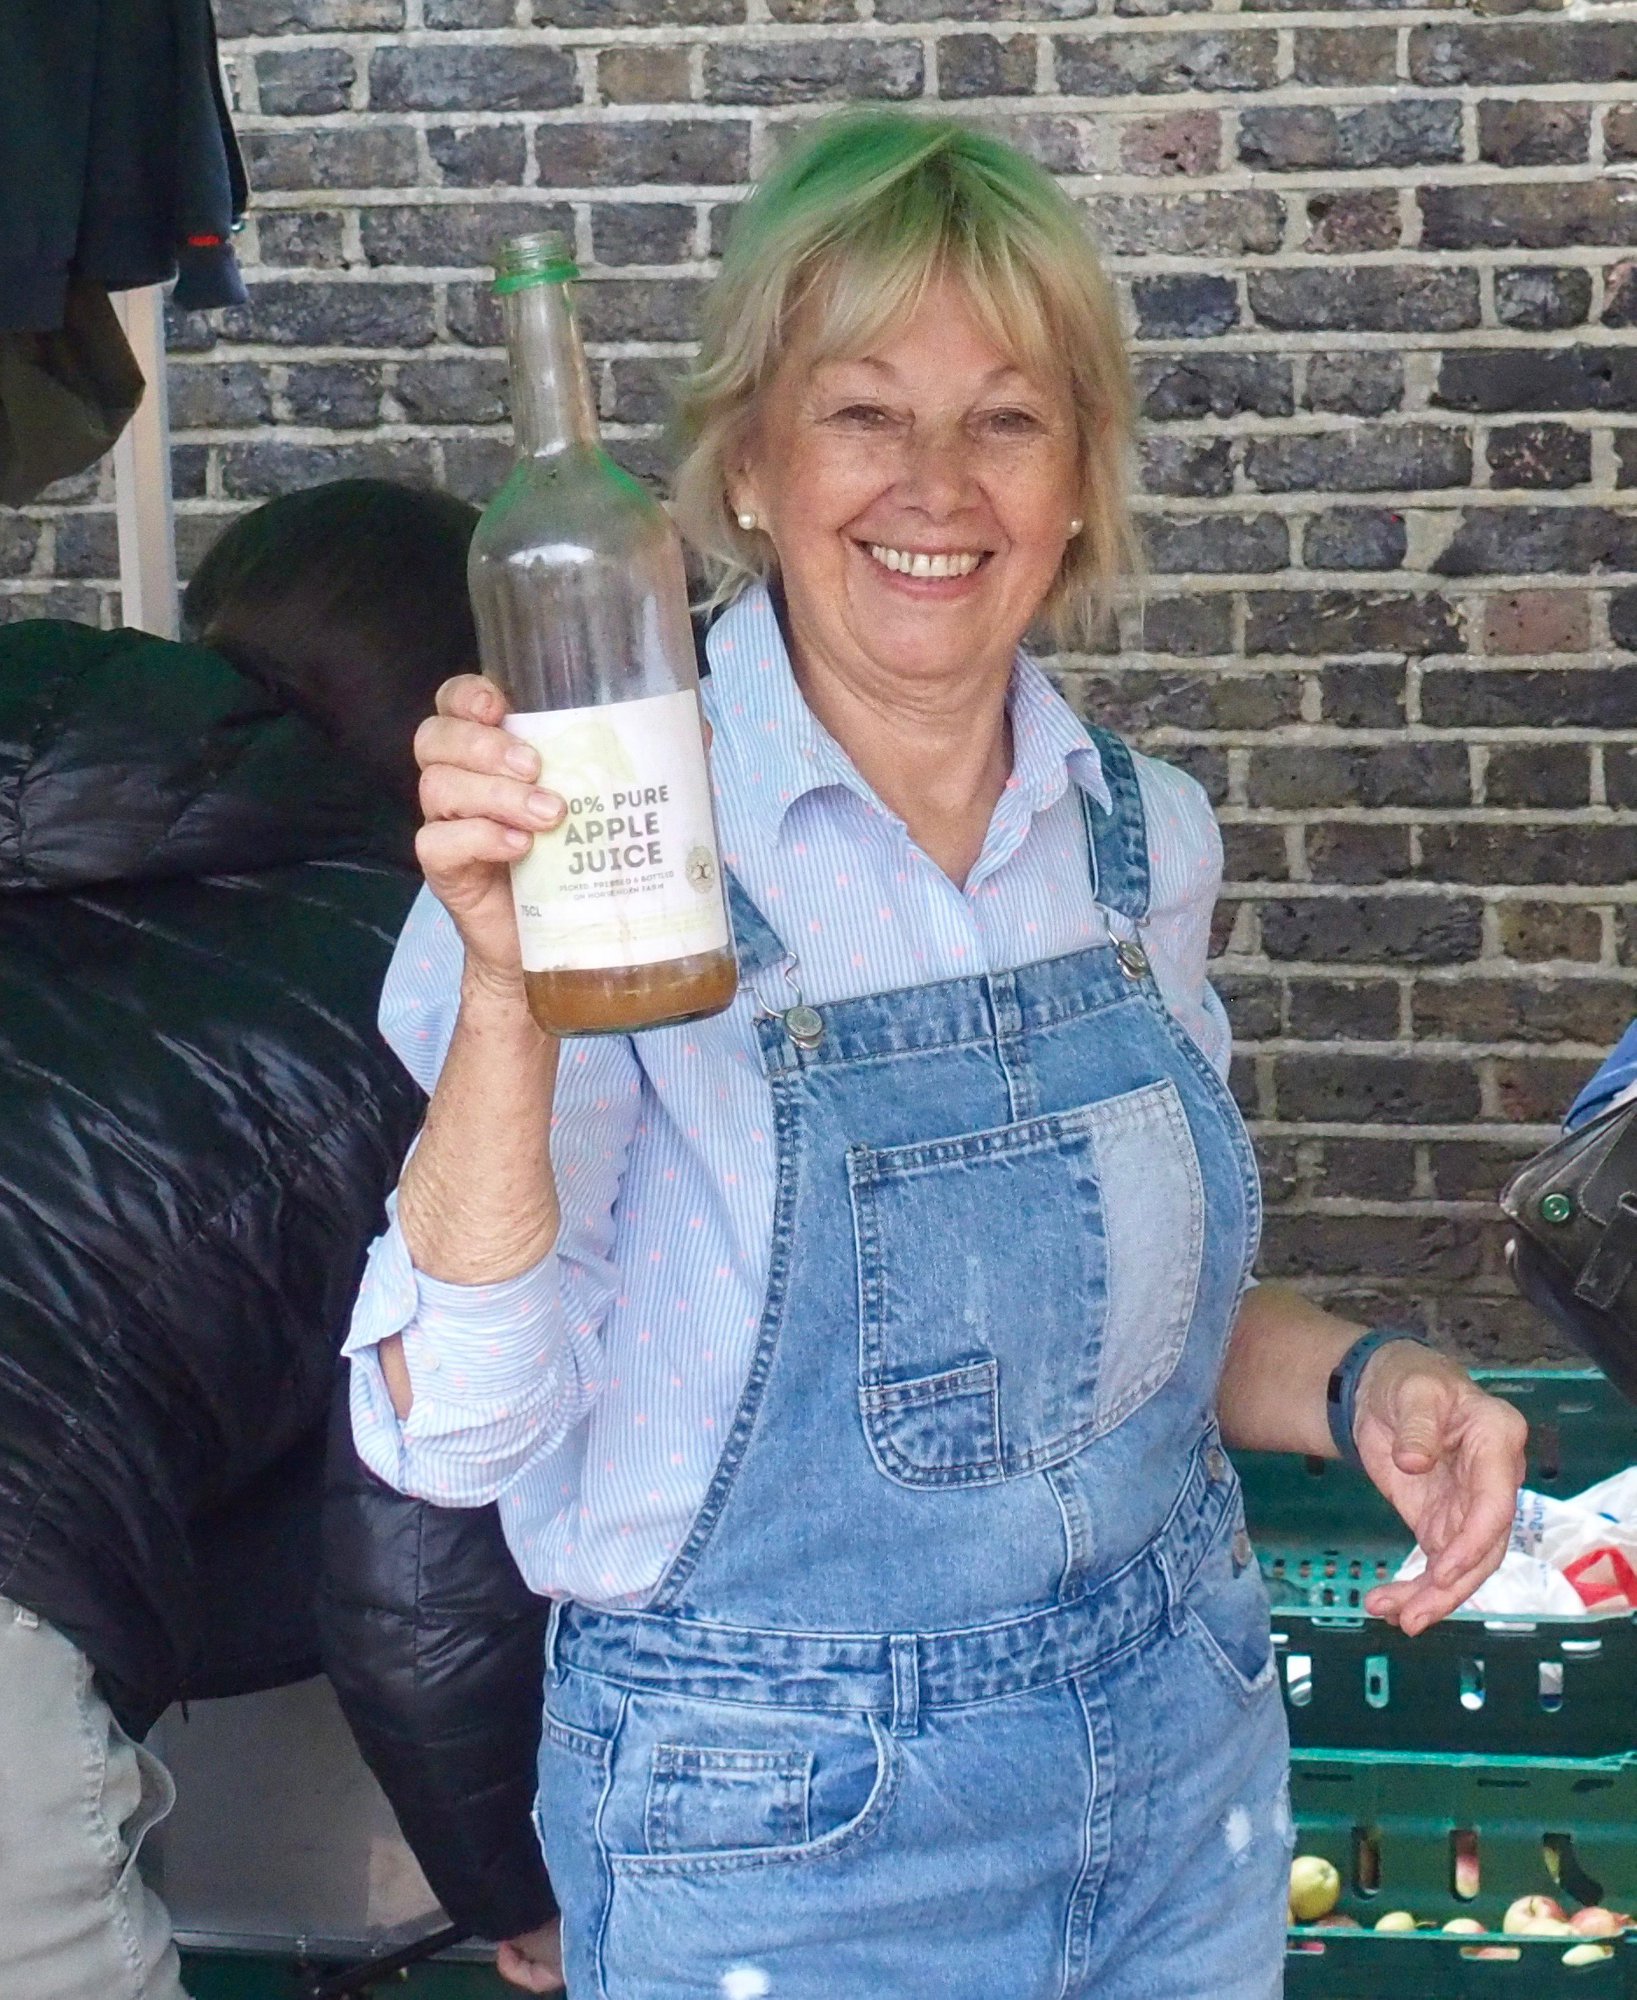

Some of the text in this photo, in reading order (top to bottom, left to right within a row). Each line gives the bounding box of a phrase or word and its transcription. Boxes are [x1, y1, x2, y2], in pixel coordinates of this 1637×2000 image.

[613, 785, 669, 810] PURE
[564, 812, 660, 846] APPLE
[568, 842, 663, 875] JUICE
[641, 870, 675, 883] BOTTLED
[520, 904, 542, 917] 75CL
